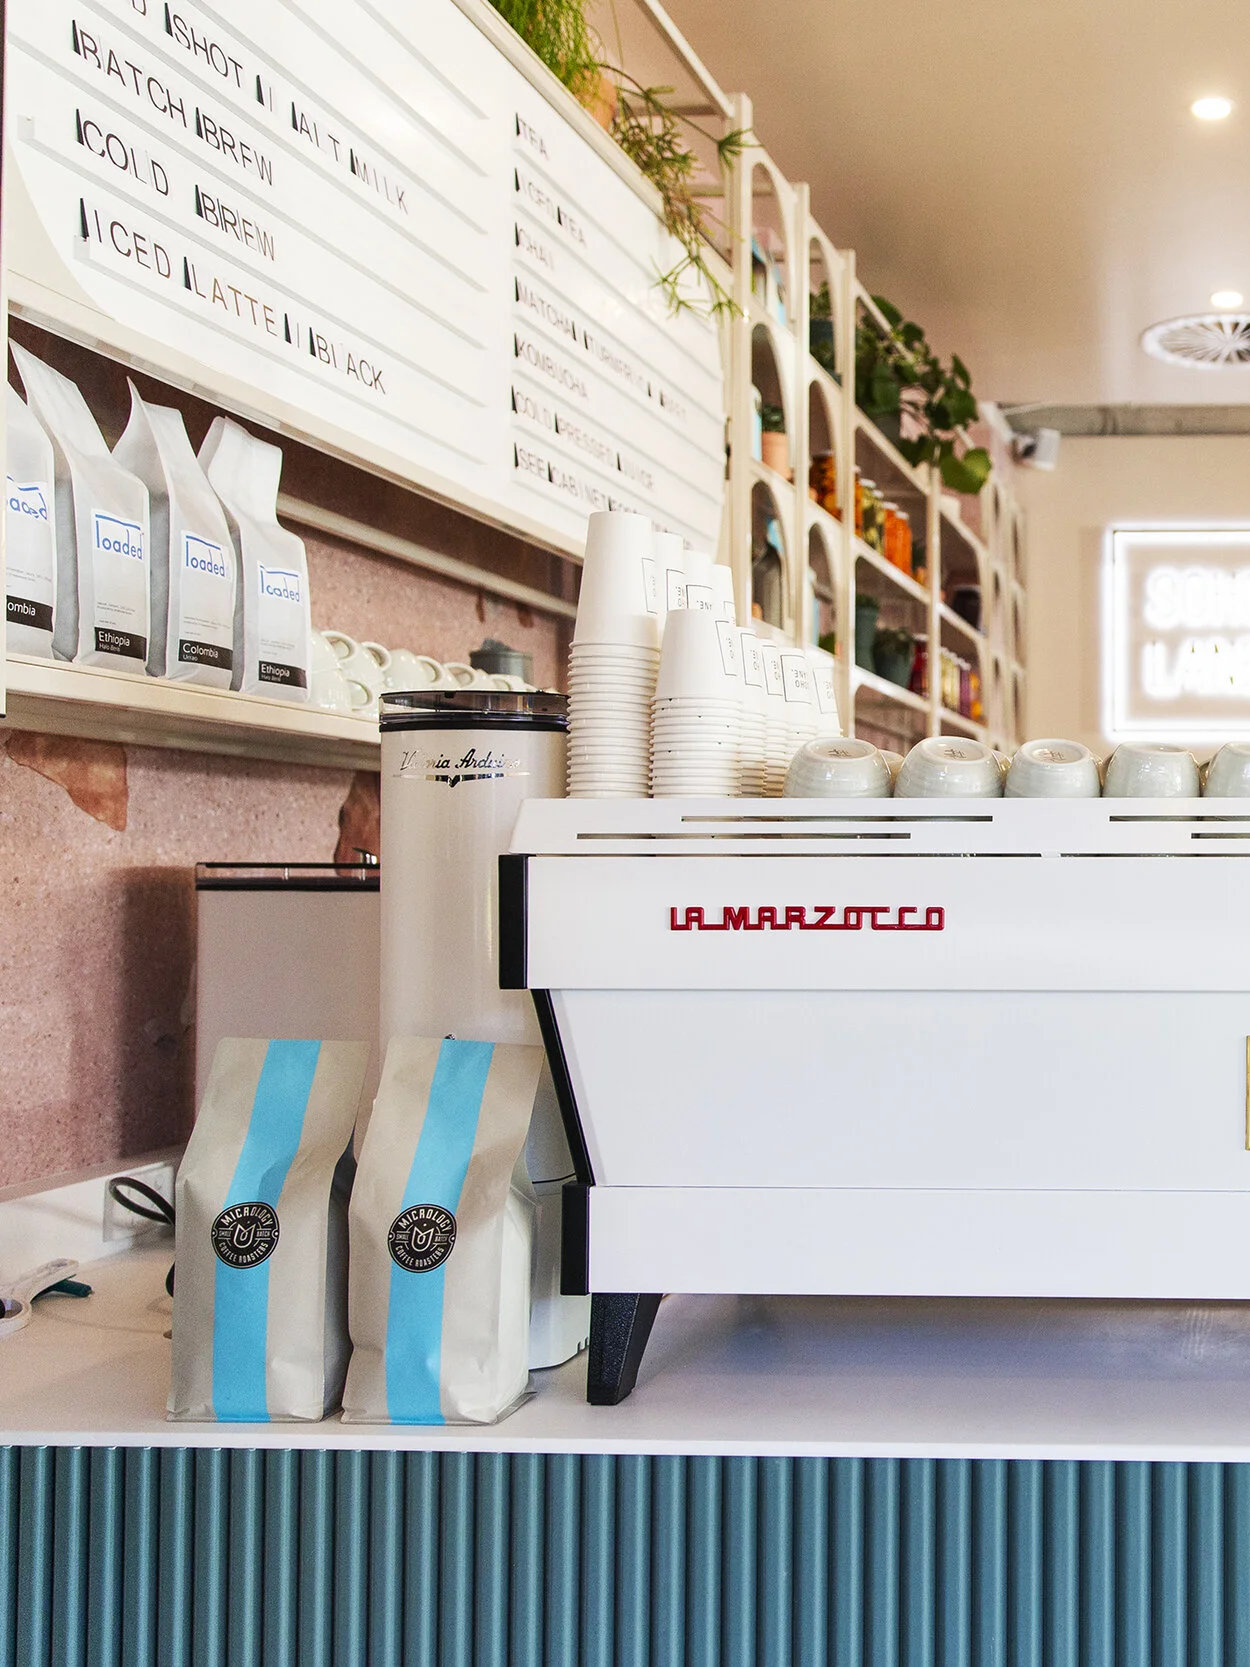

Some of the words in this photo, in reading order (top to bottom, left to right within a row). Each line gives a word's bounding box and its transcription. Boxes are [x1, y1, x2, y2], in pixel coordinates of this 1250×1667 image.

[173, 14, 243, 88] SHOT
[355, 155, 408, 215] MILK
[202, 114, 273, 186] BREW
[519, 118, 549, 161] TEA
[83, 120, 169, 196] COLD
[201, 192, 274, 261] BREW
[560, 210, 587, 248] TEA
[518, 228, 554, 271] CHAI
[94, 209, 171, 279] ICED
[191, 264, 278, 337] LATTE
[518, 281, 571, 335] MATCHA
[518, 337, 589, 401] KOMBUCHA
[514, 391, 552, 431] COLD
[558, 417, 616, 468] PRESSED
[519, 447, 548, 481] SEE
[551, 466, 607, 509] CABINET
[94, 517, 143, 560] loaded
[185, 540, 225, 577] loaded
[7, 600, 36, 617] ombia
[98, 630, 130, 648] Ethiopia
[182, 643, 218, 659] Colombia
[261, 663, 290, 678] Ethiopia
[670, 906, 704, 931] LA
[722, 906, 945, 931] MARZOCCO
[220, 1207, 273, 1226] MICROLOGY
[398, 1208, 452, 1232] MICROLOGY
[219, 1242, 237, 1262] COFFEE
[239, 1242, 268, 1263] ROASTERS
[395, 1245, 413, 1266] COFFEE
[415, 1247, 444, 1267] ROASTERS
